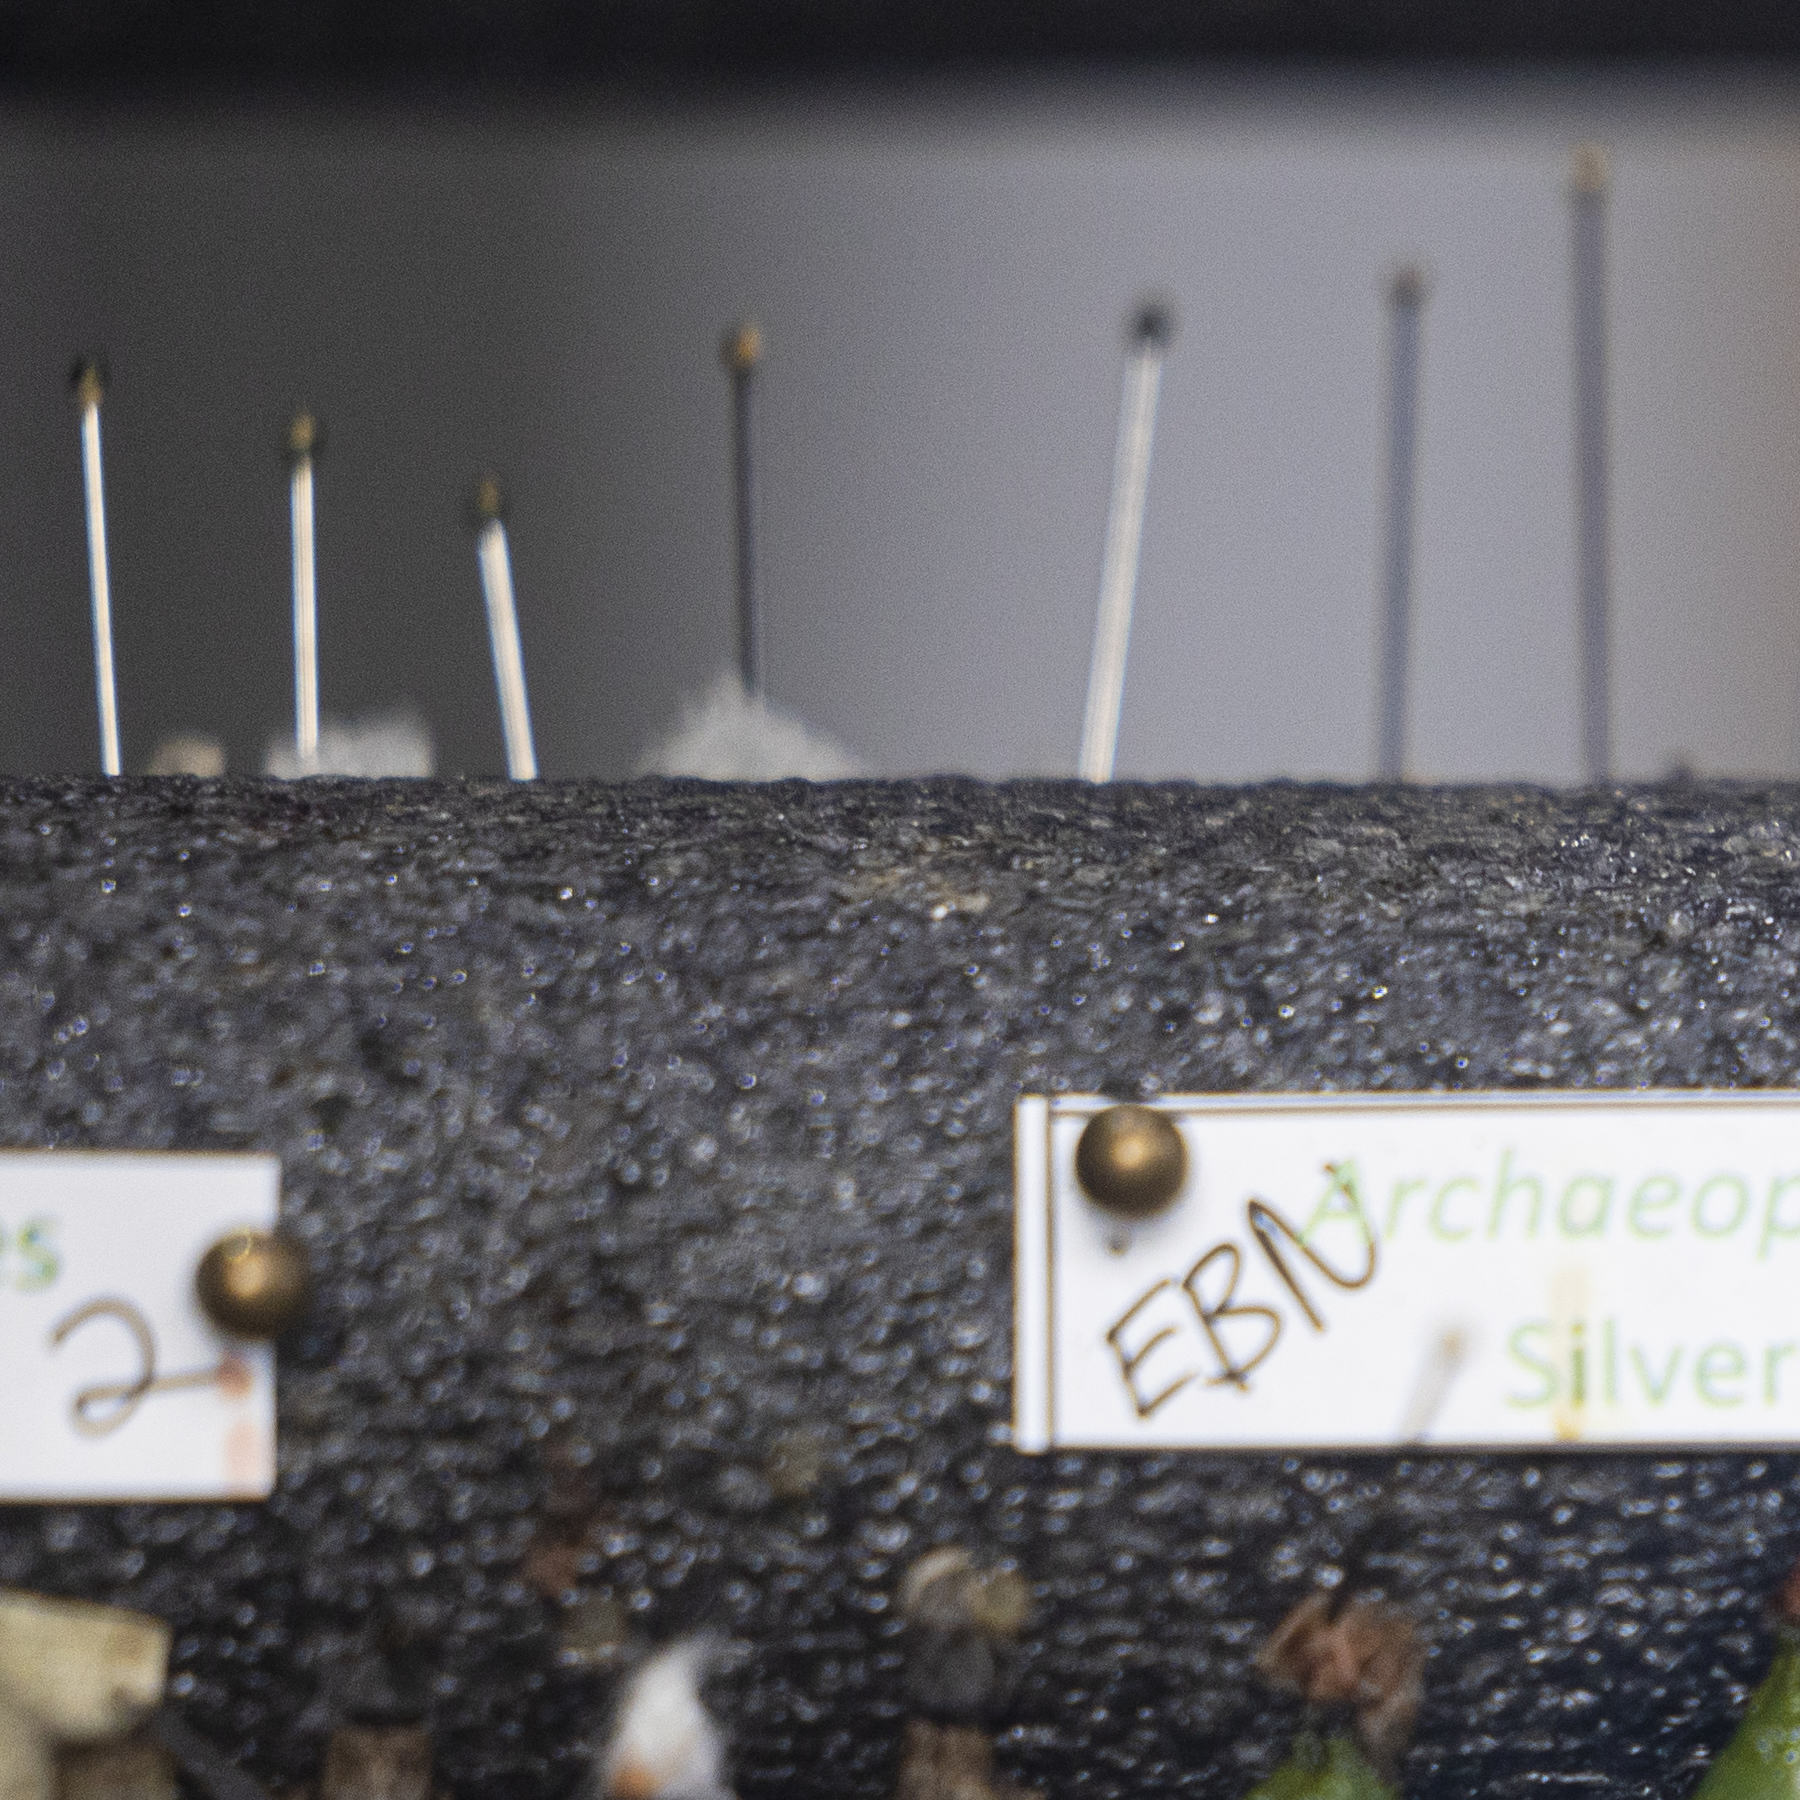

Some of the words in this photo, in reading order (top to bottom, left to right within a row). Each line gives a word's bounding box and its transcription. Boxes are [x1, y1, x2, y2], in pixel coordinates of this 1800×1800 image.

[0, 1217, 60, 1294] s
[1106, 1162, 1378, 1421] EBN
[47, 1294, 228, 1439] 2
[1506, 1315, 1797, 1410] Silver
